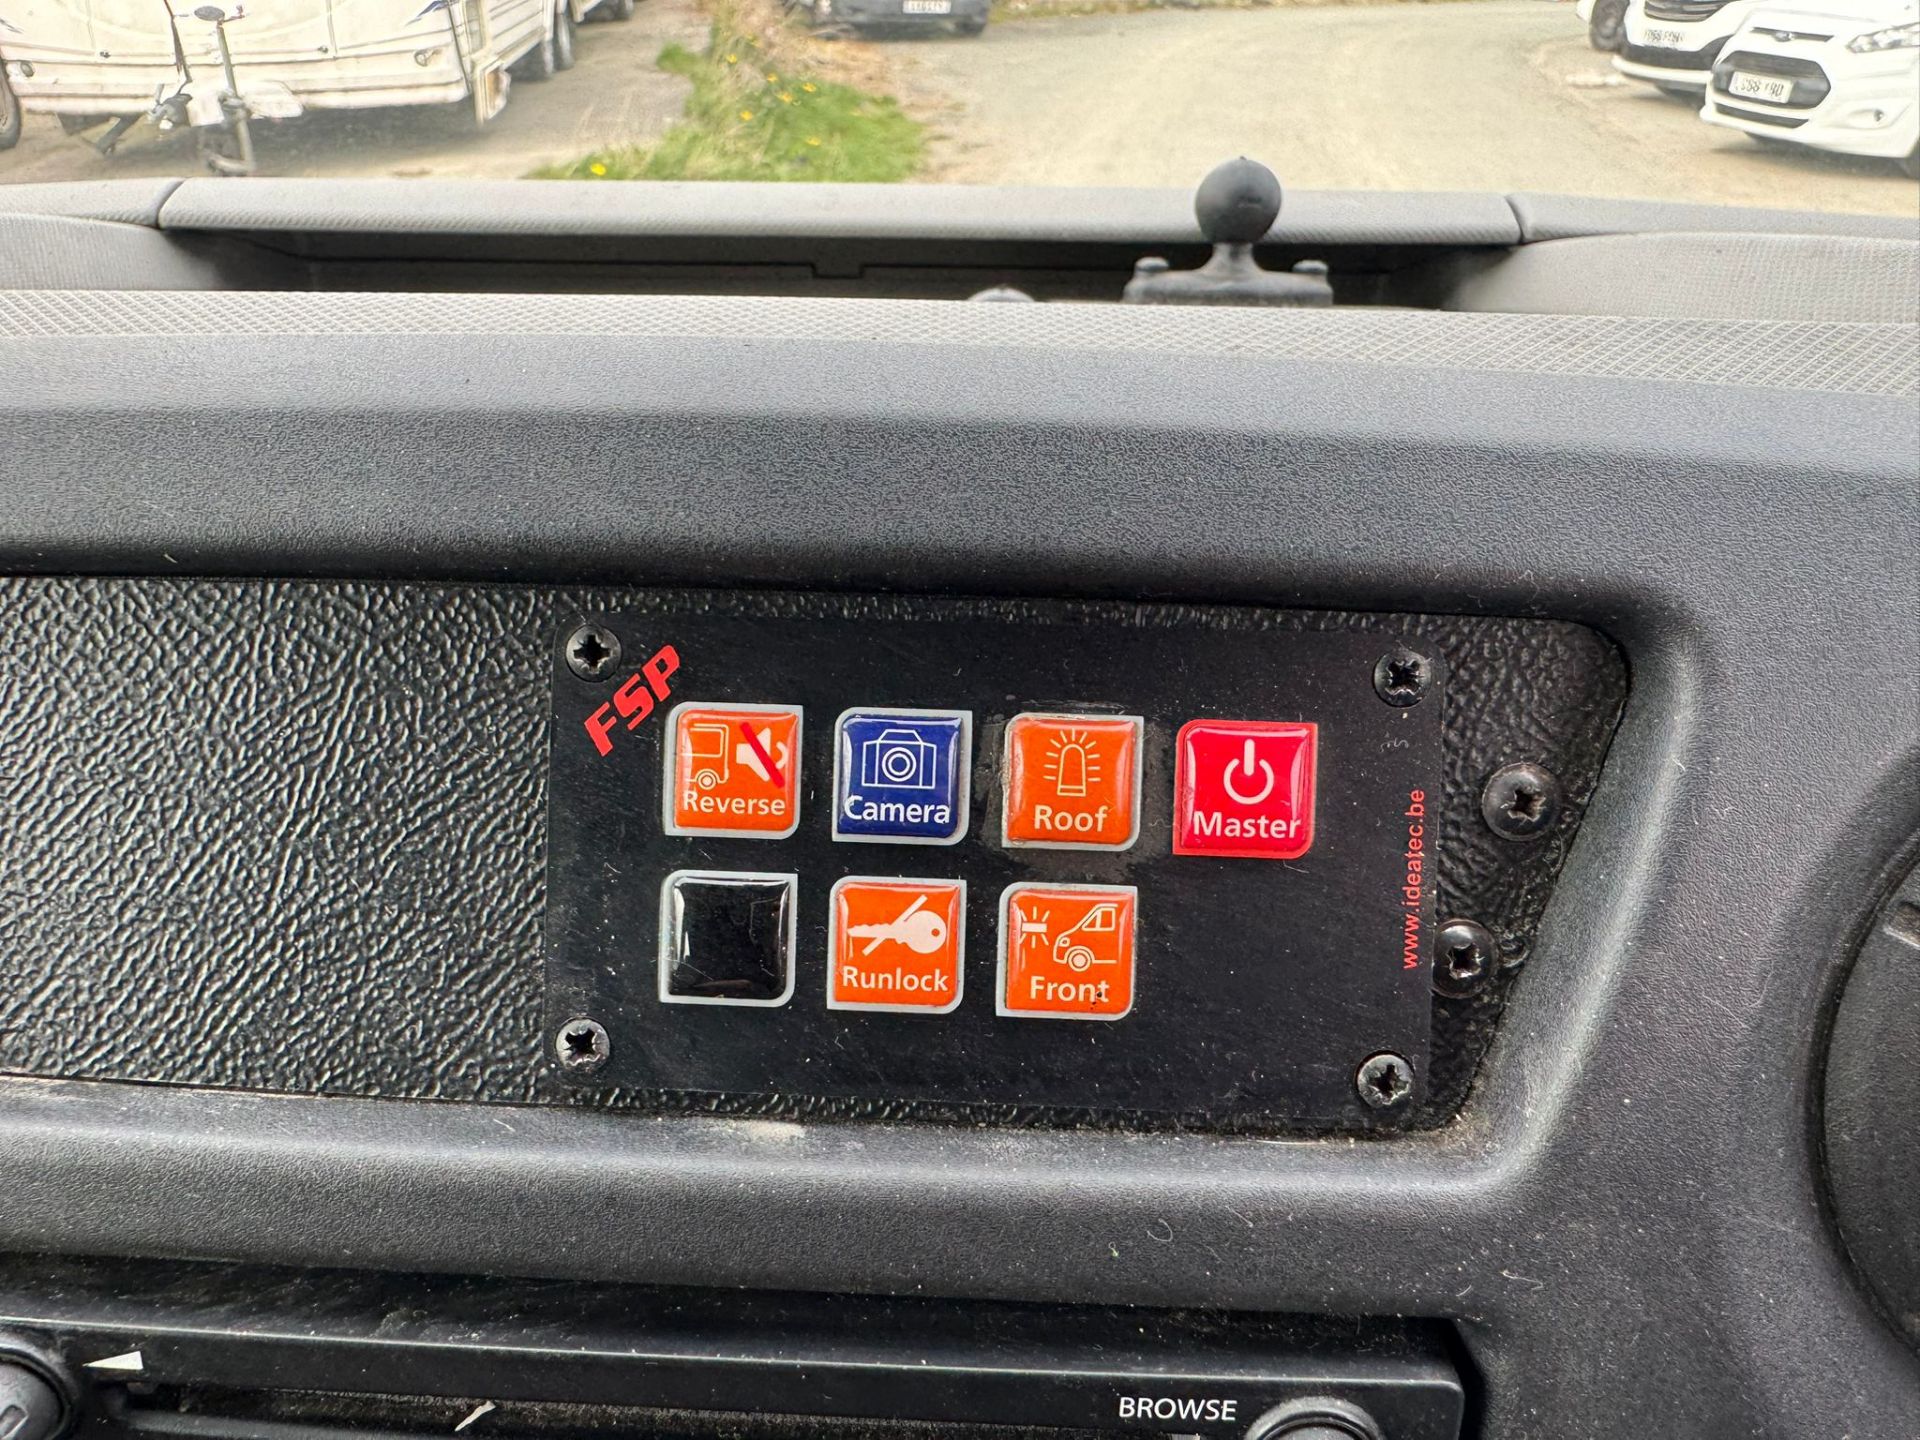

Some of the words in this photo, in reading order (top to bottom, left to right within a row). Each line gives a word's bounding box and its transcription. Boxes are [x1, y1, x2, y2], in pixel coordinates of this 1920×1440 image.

[583, 644, 681, 757] FSP
[682, 791, 787, 816] Reverse
[843, 795, 951, 824] Camera
[1033, 804, 1110, 832] Roof
[1192, 810, 1301, 839] Master
[1402, 788, 1425, 970] www.ideatec.be
[841, 966, 950, 992] Runlock
[1029, 976, 1110, 1003] Front
[1118, 1396, 1238, 1421] BROWSE
